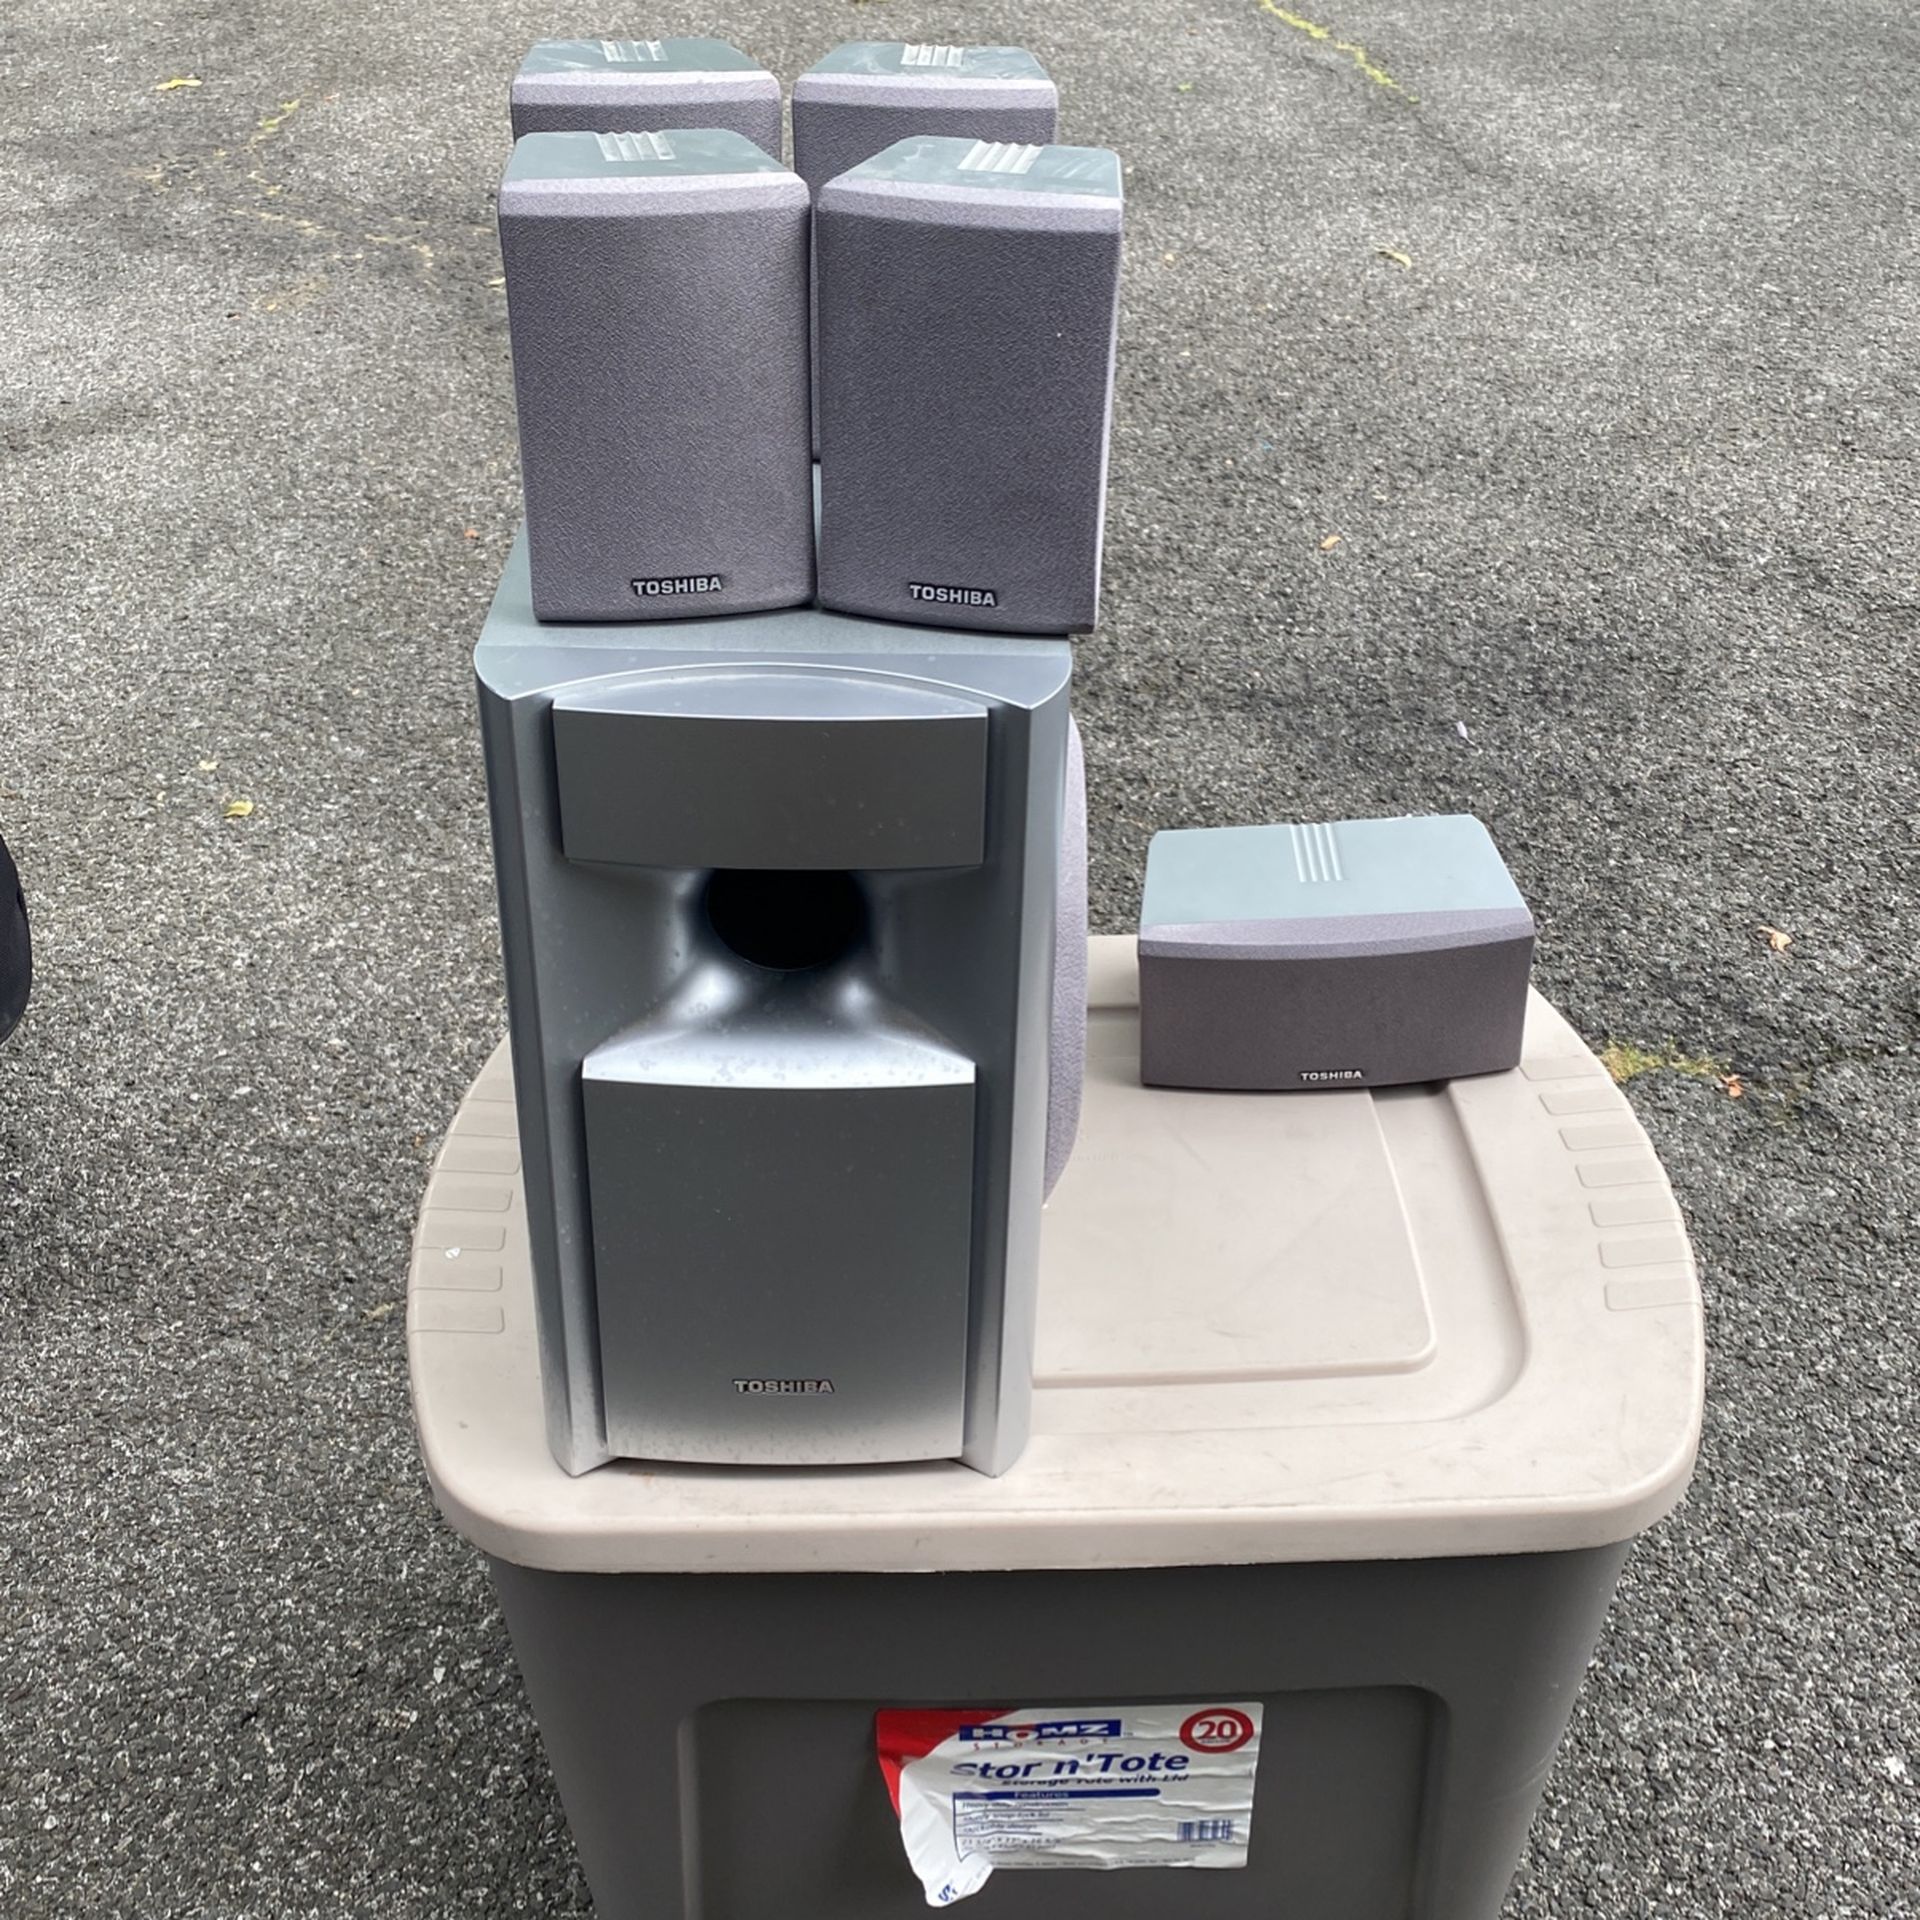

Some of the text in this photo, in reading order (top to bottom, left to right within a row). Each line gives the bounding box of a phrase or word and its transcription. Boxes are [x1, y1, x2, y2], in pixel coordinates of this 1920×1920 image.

[632, 575, 723, 596] TOSHIBA
[909, 583, 998, 607] TOSHIBA
[1299, 1069, 1363, 1081] TOSHIBA
[733, 1379, 834, 1393] TOSHIBA
[972, 1722, 1110, 1742] HOMZ
[1197, 1720, 1238, 1739] 20
[950, 1762, 1042, 1779] Stor
